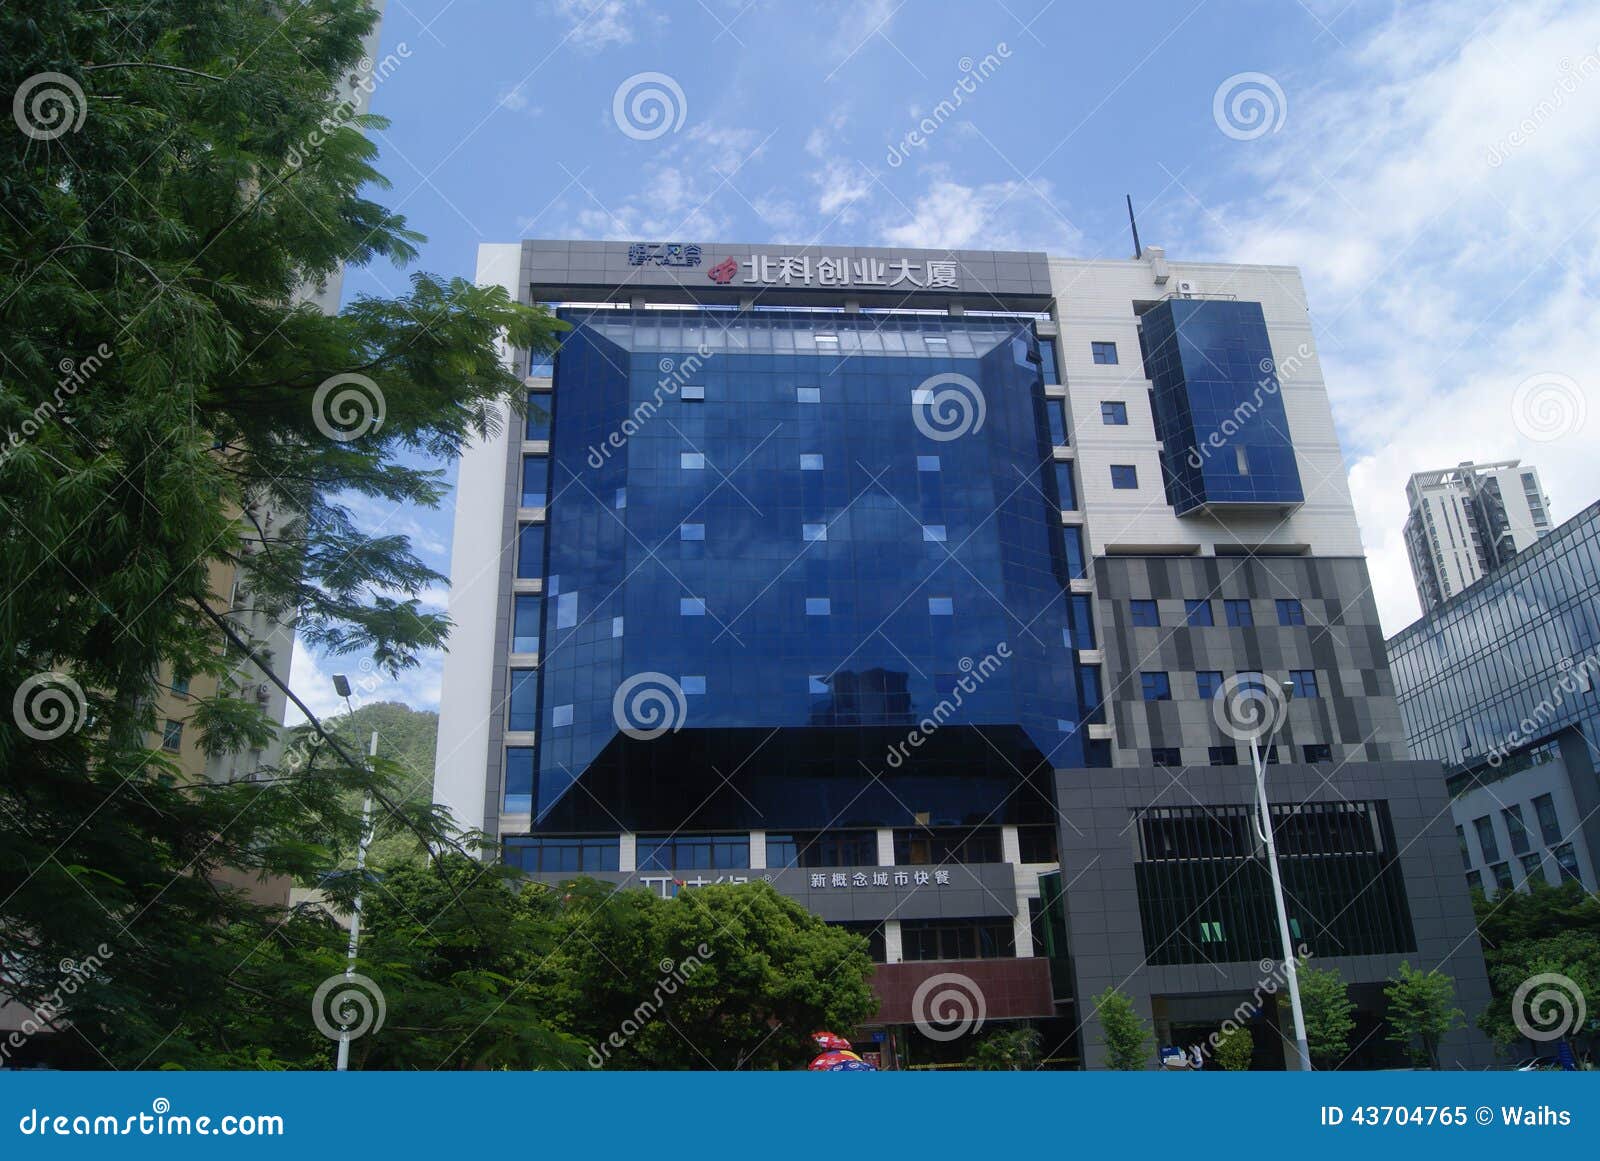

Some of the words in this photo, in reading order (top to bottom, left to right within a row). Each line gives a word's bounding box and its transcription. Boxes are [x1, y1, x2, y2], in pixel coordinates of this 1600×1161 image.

[743, 254, 959, 289] 北科创业大厦
[810, 870, 951, 888] 新概念城市快餐
